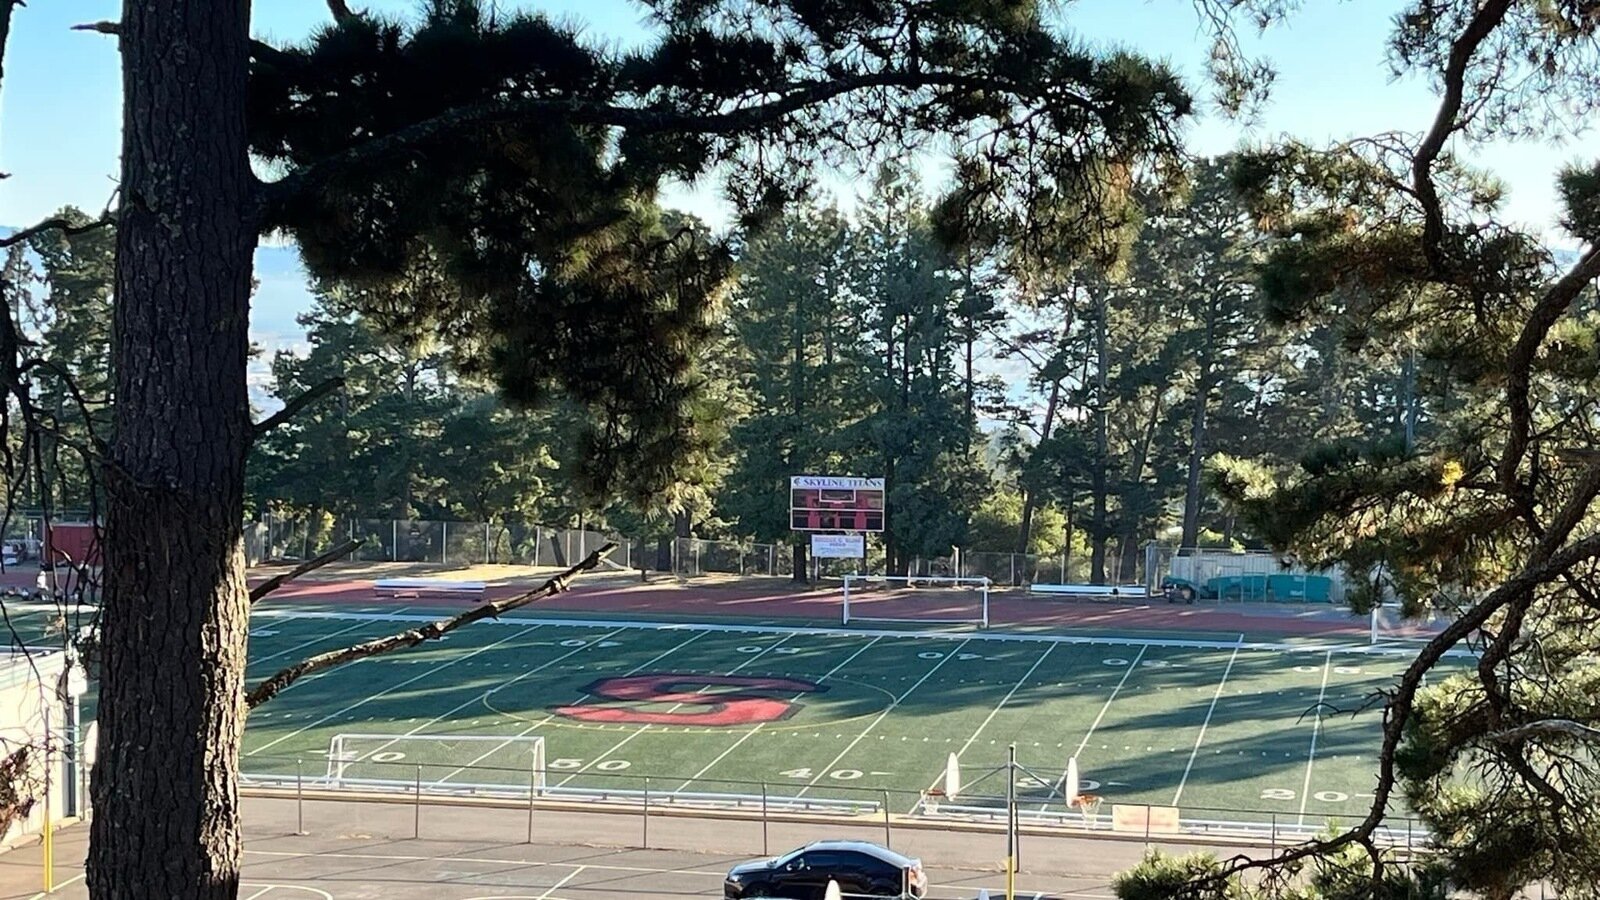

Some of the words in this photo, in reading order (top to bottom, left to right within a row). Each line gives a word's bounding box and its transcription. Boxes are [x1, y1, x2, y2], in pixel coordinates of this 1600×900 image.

[803, 478, 843, 488] SKYLINE
[848, 478, 882, 488] TITANS
[548, 674, 831, 726] S
[548, 757, 632, 771] 50
[779, 767, 864, 780] 40
[1260, 788, 1349, 802] 20
